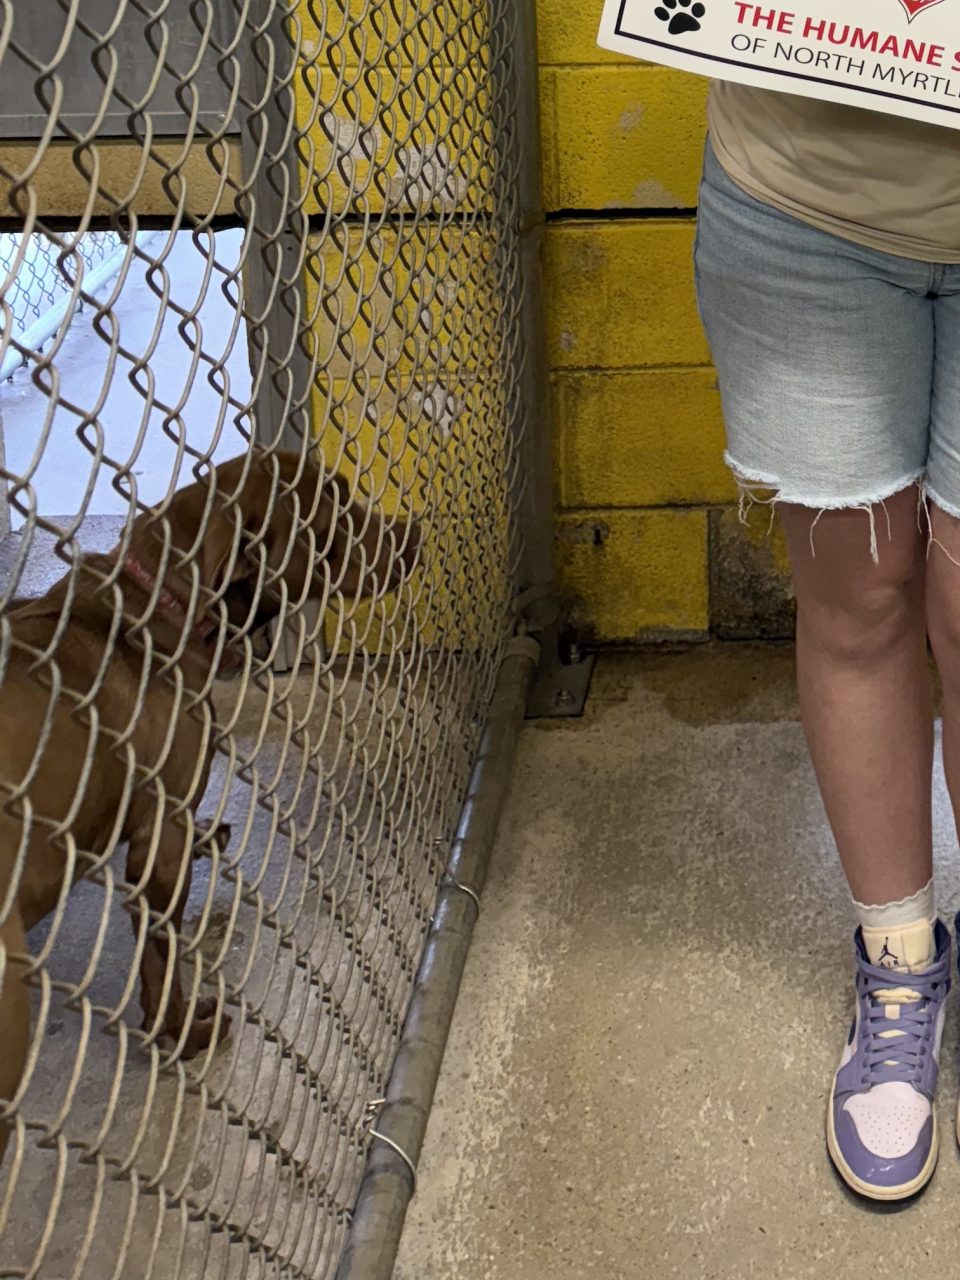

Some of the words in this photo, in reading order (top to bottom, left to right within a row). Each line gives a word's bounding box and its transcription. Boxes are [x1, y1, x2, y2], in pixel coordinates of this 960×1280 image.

[730, 33, 768, 54] OF
[773, 42, 865, 76] NORTH
[734, 1, 794, 34] THE
[802, 17, 945, 67] HUMANE
